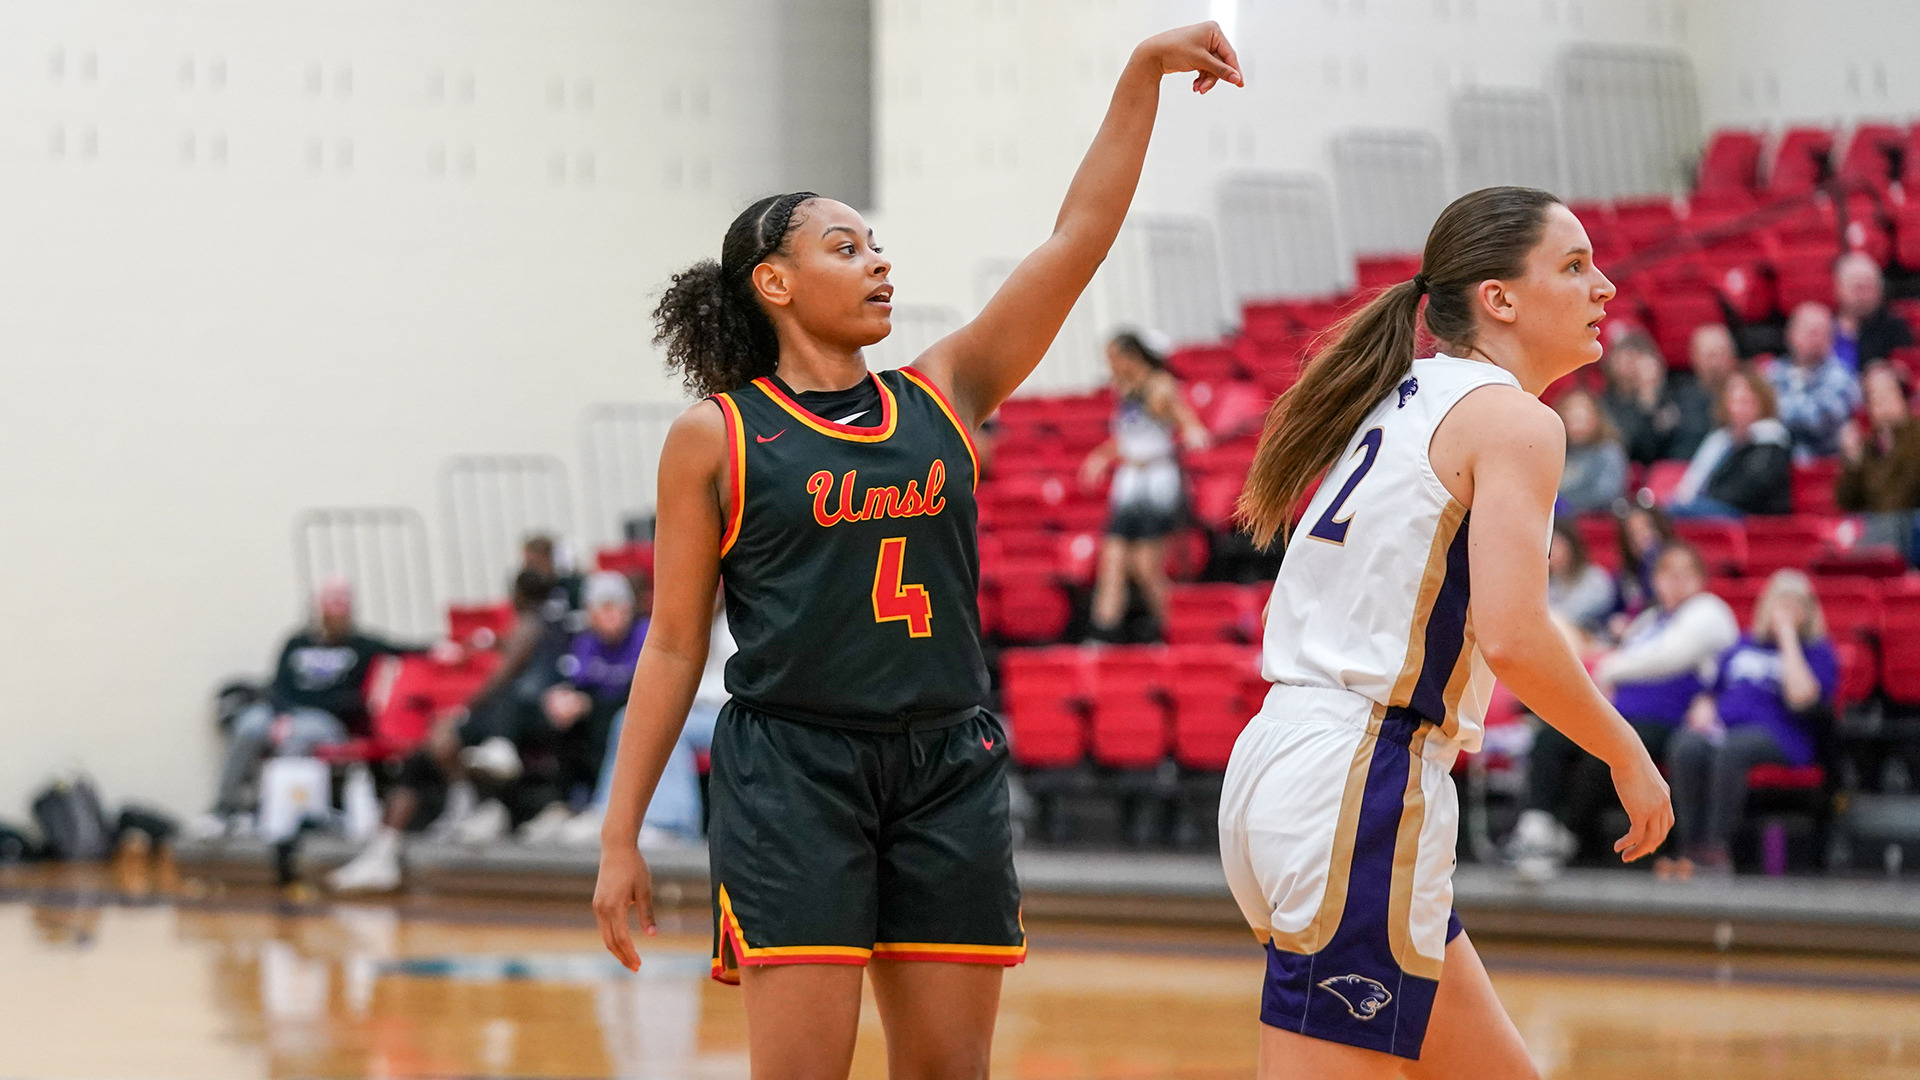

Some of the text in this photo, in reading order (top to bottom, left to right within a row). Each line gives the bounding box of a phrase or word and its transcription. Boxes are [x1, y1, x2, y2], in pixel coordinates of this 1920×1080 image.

[806, 459, 946, 528] Umsl
[1306, 425, 1385, 547] 2
[871, 537, 933, 638] 4
